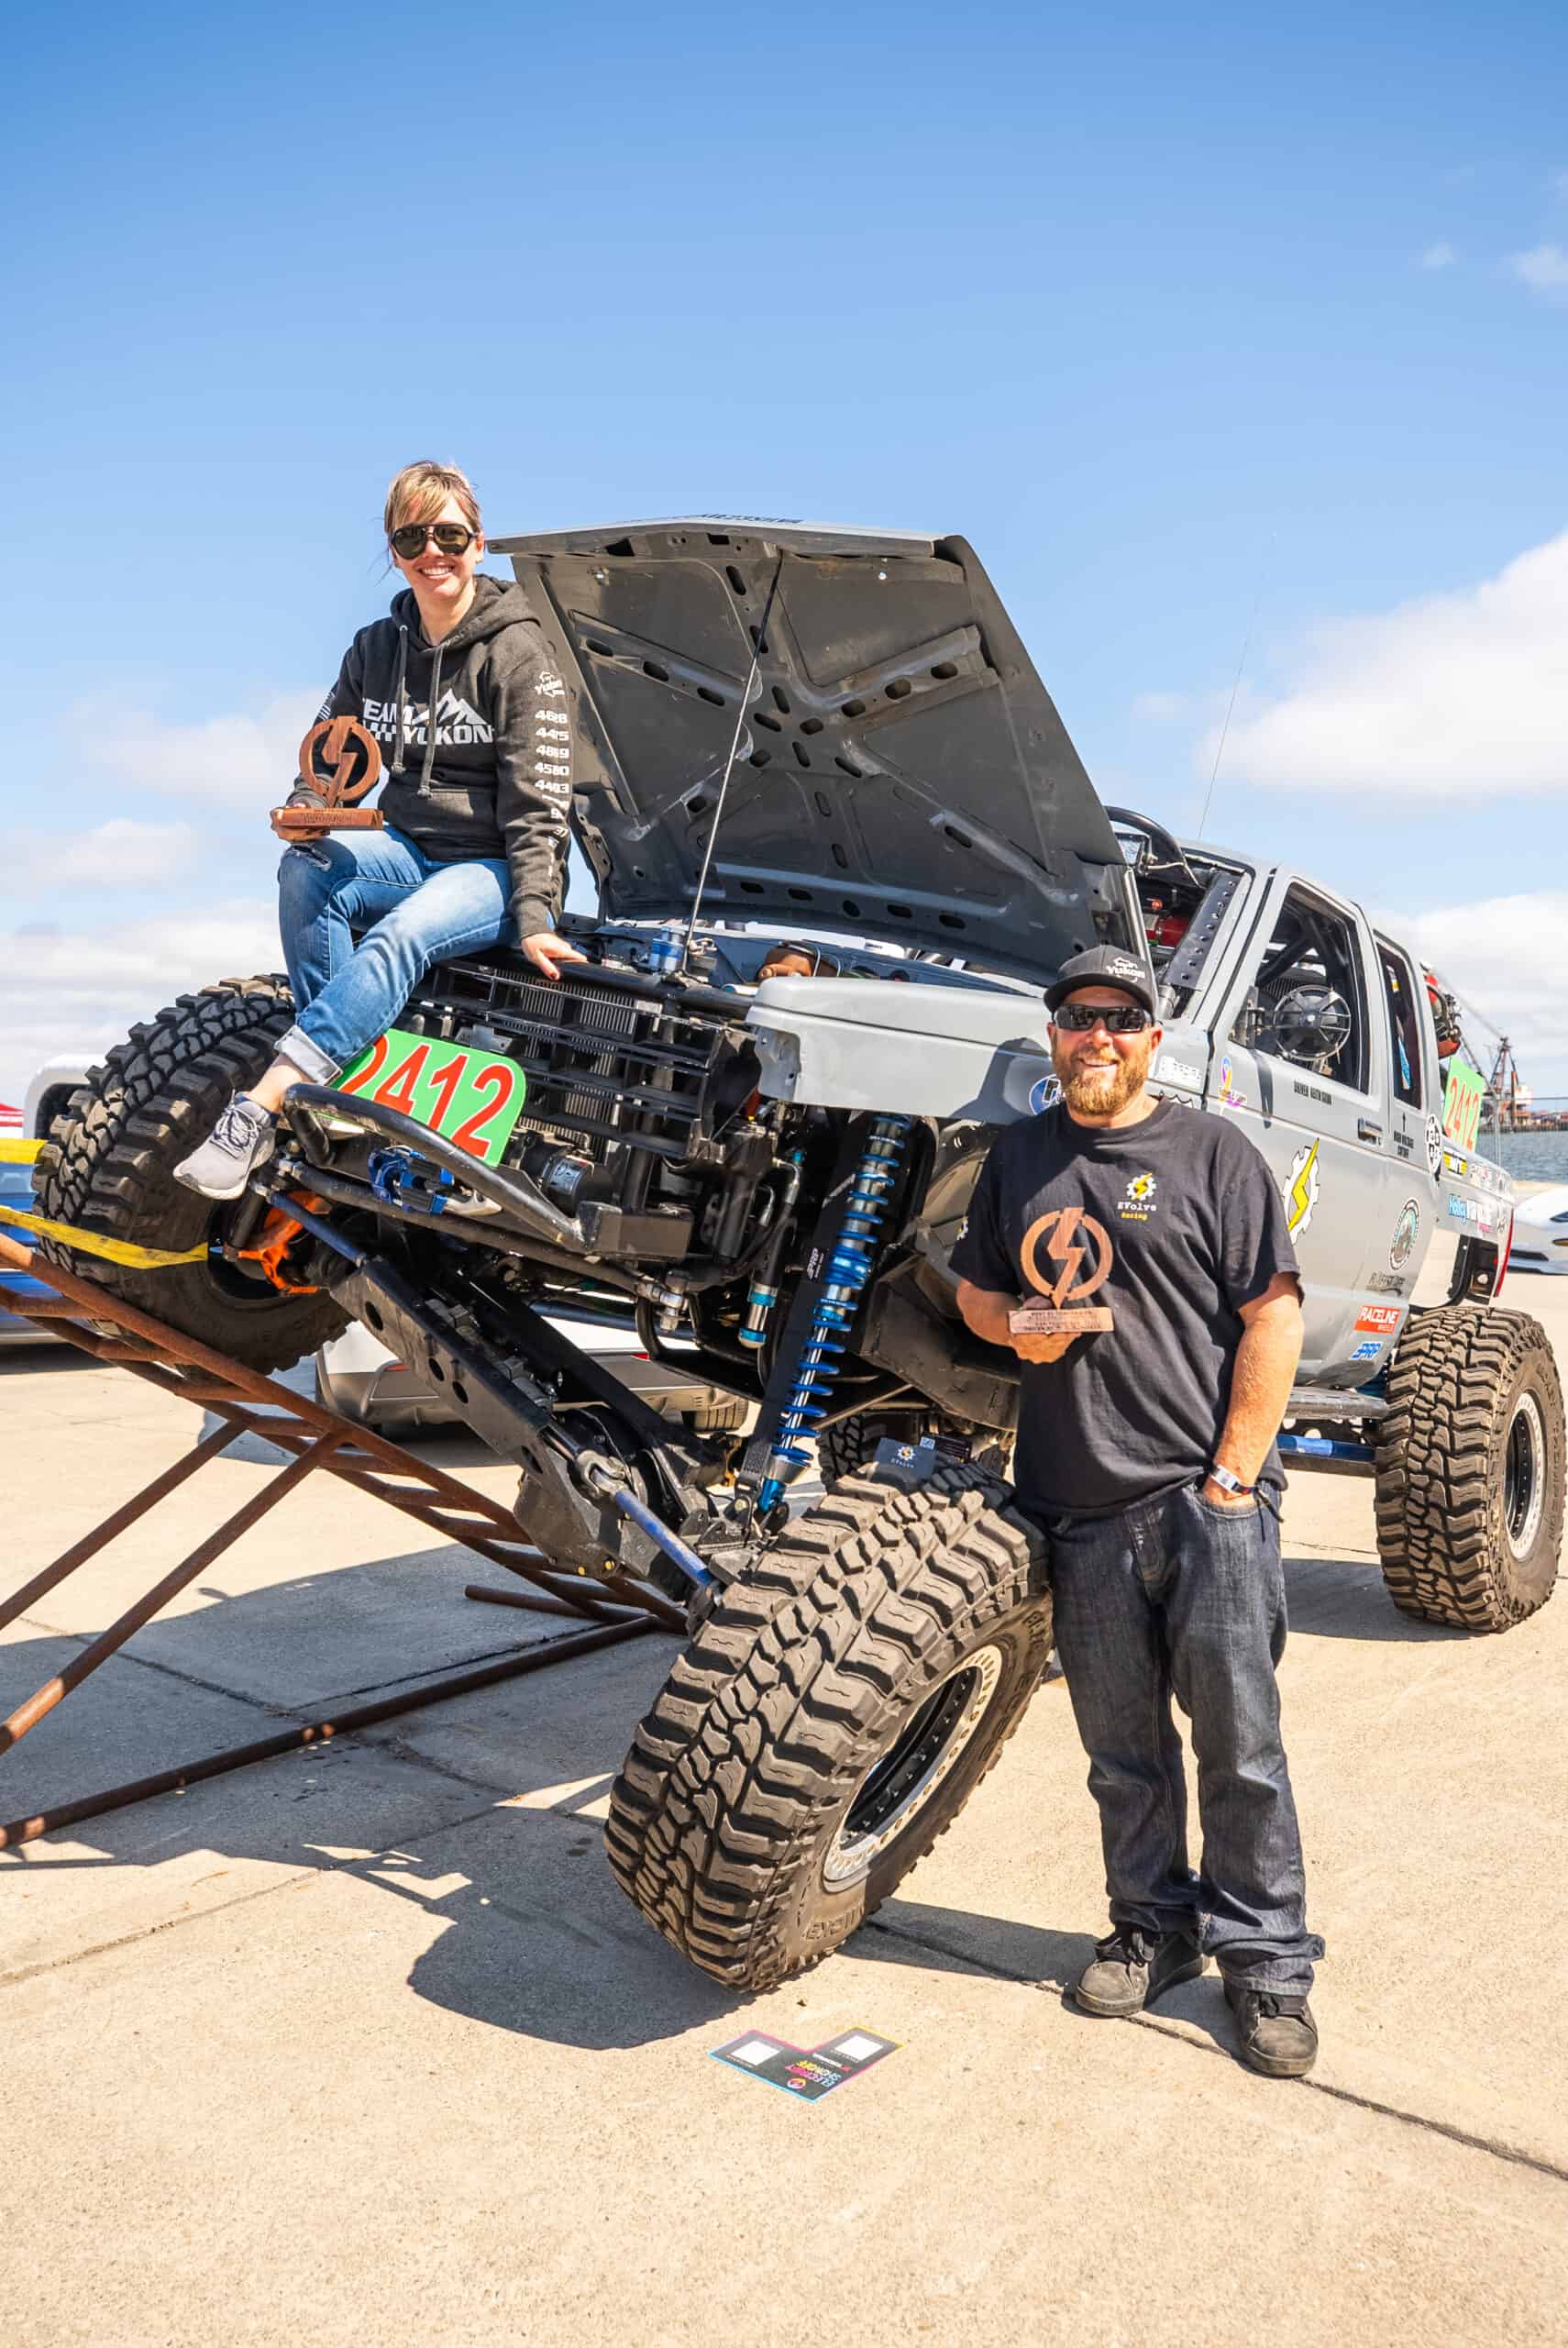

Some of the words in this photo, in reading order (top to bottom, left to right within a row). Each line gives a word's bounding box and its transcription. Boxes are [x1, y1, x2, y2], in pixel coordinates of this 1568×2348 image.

[362, 697, 413, 725] EAM
[1443, 1077, 1480, 1151] 2412
[1358, 1306, 1399, 1324] RACELINE
